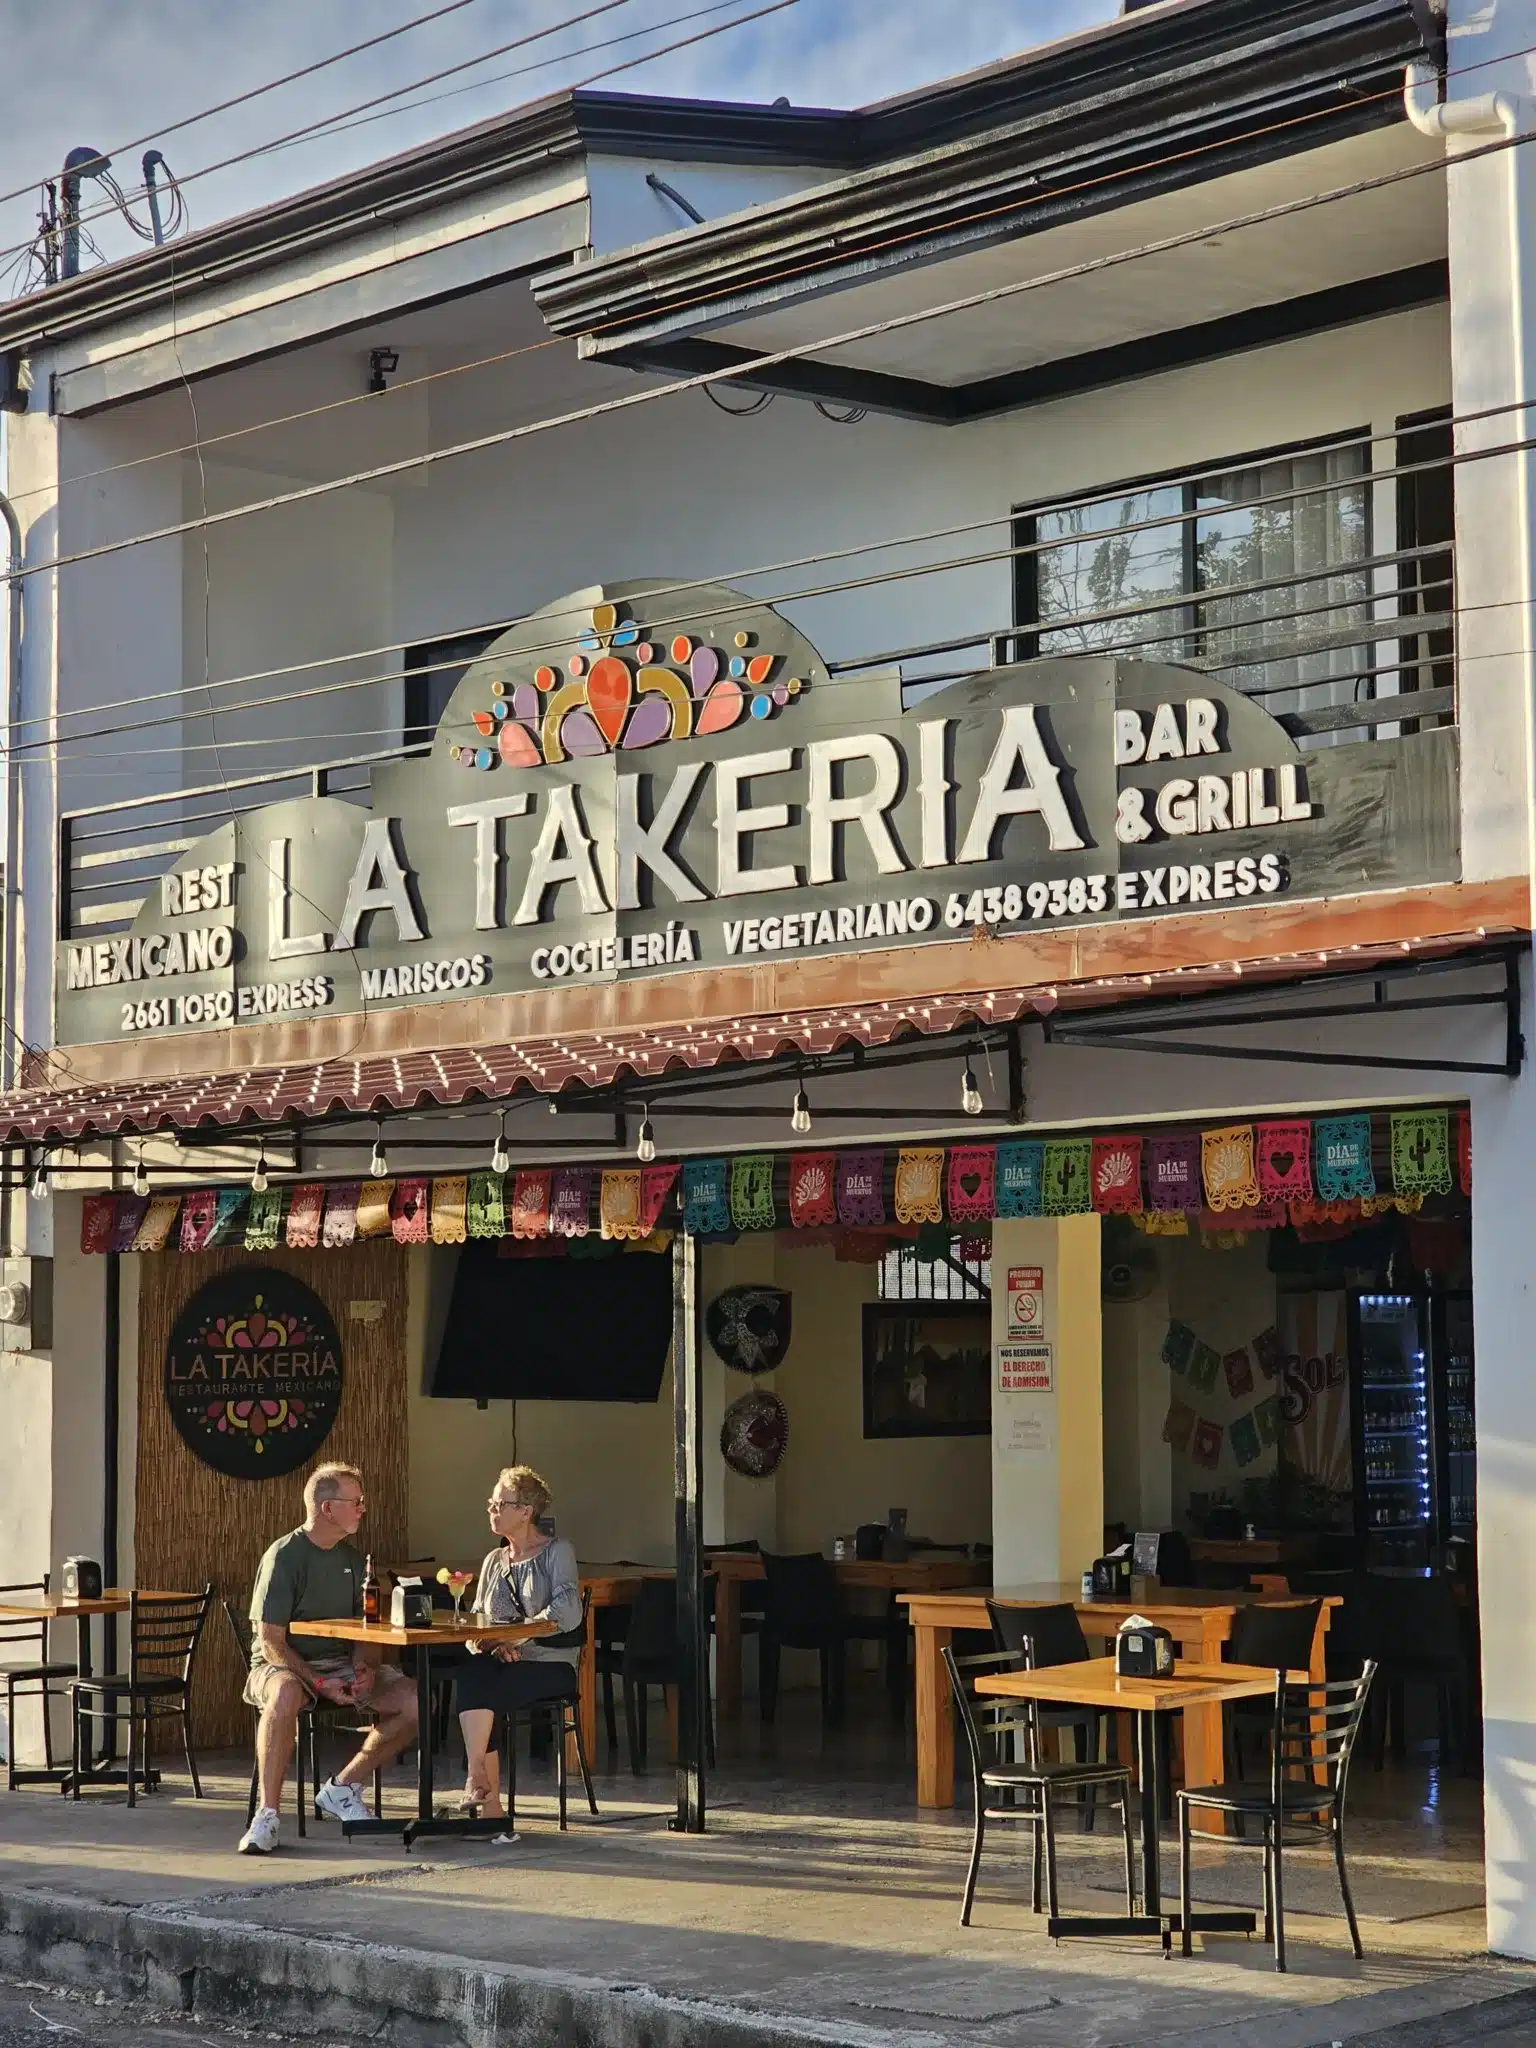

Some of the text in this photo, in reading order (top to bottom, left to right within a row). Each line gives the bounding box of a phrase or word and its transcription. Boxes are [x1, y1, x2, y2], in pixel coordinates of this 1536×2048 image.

[1114, 697, 1220, 766] BAR
[1115, 764, 1312, 843] & GRILL
[268, 702, 1086, 961] LA TAKERIA
[161, 861, 237, 917] REST
[944, 853, 1283, 928] 6438 9383 EXPRESS
[723, 897, 934, 955] VEGETARIANO
[66, 924, 234, 991] MEXICANO
[530, 920, 695, 979] COCTELERÍA
[360, 955, 488, 1000] MARISCOS
[120, 975, 329, 1032] 2661 1050 EXPRESS
[1158, 1160, 1179, 1175] DÍA
[1327, 1142, 1350, 1159] DÍA
[1327, 1157, 1360, 1167] MUERTOS
[846, 1174, 865, 1188] DÍA
[1004, 1164, 1023, 1180] DÍA
[1158, 1174, 1188, 1182] MUERTOS
[559, 1188, 574, 1202] DÍA
[170, 1346, 339, 1380] LA TAKERÍA
[1000, 1348, 1050, 1358] NOS RESERVAMOS
[1003, 1361, 1046, 1372] EL DERECHO
[1002, 1376, 1050, 1388] DE ADMISION
